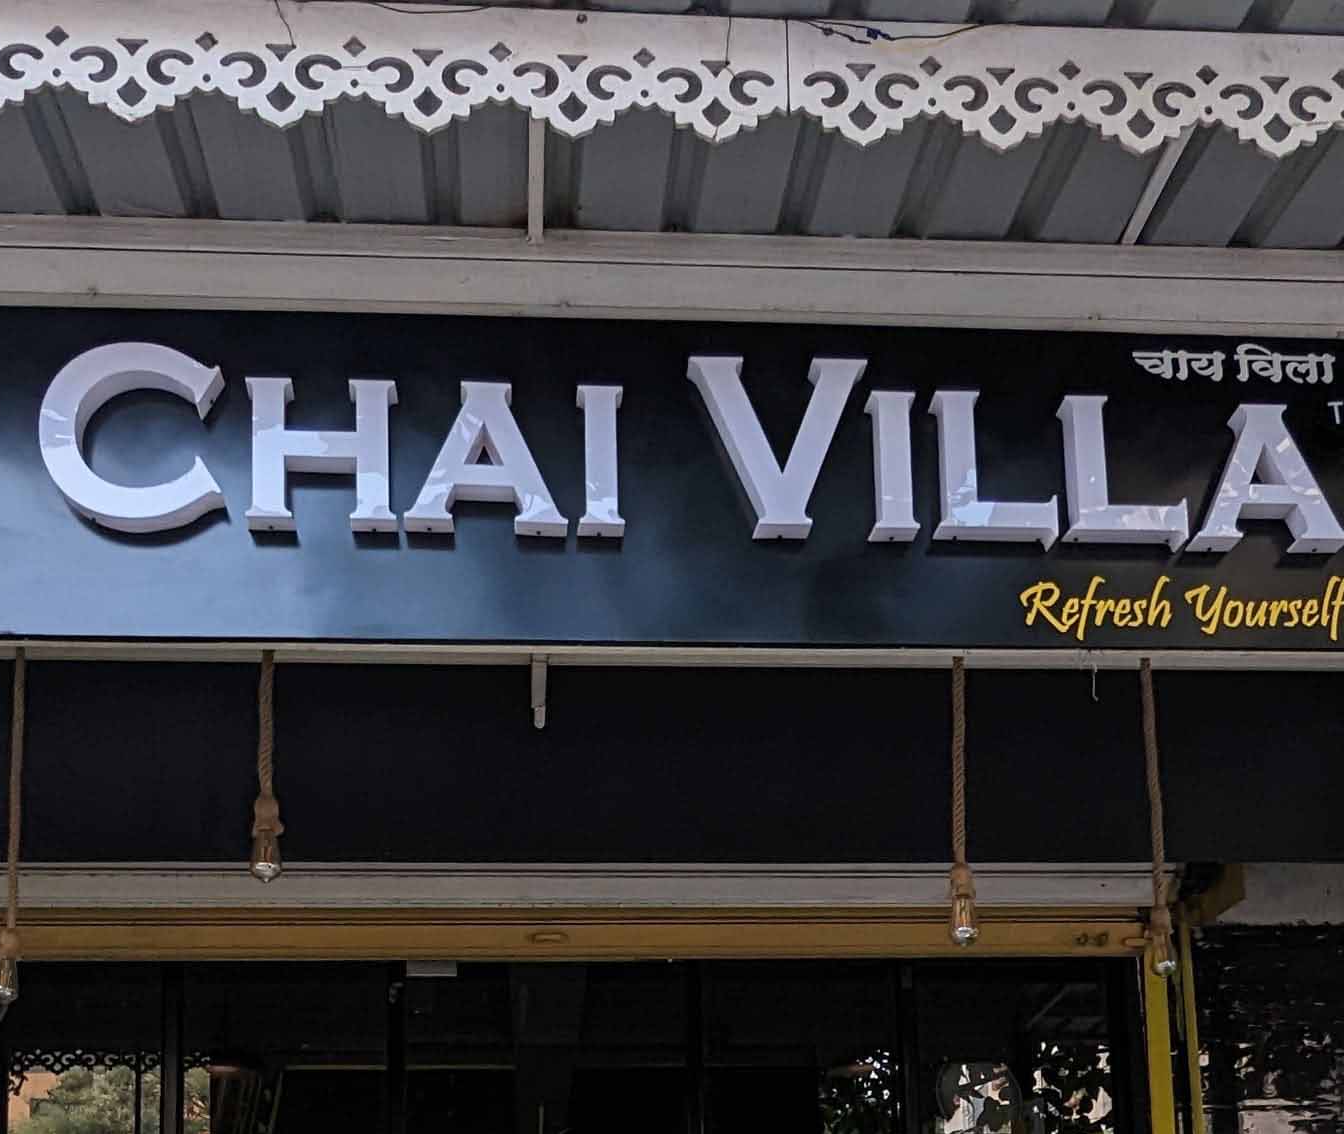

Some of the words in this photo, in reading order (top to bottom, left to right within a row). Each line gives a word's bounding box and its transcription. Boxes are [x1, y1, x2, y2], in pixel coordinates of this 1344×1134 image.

[1131, 350, 1226, 383] चाय
[1234, 343, 1337, 385] विला
[1019, 575, 1174, 641] Refresh
